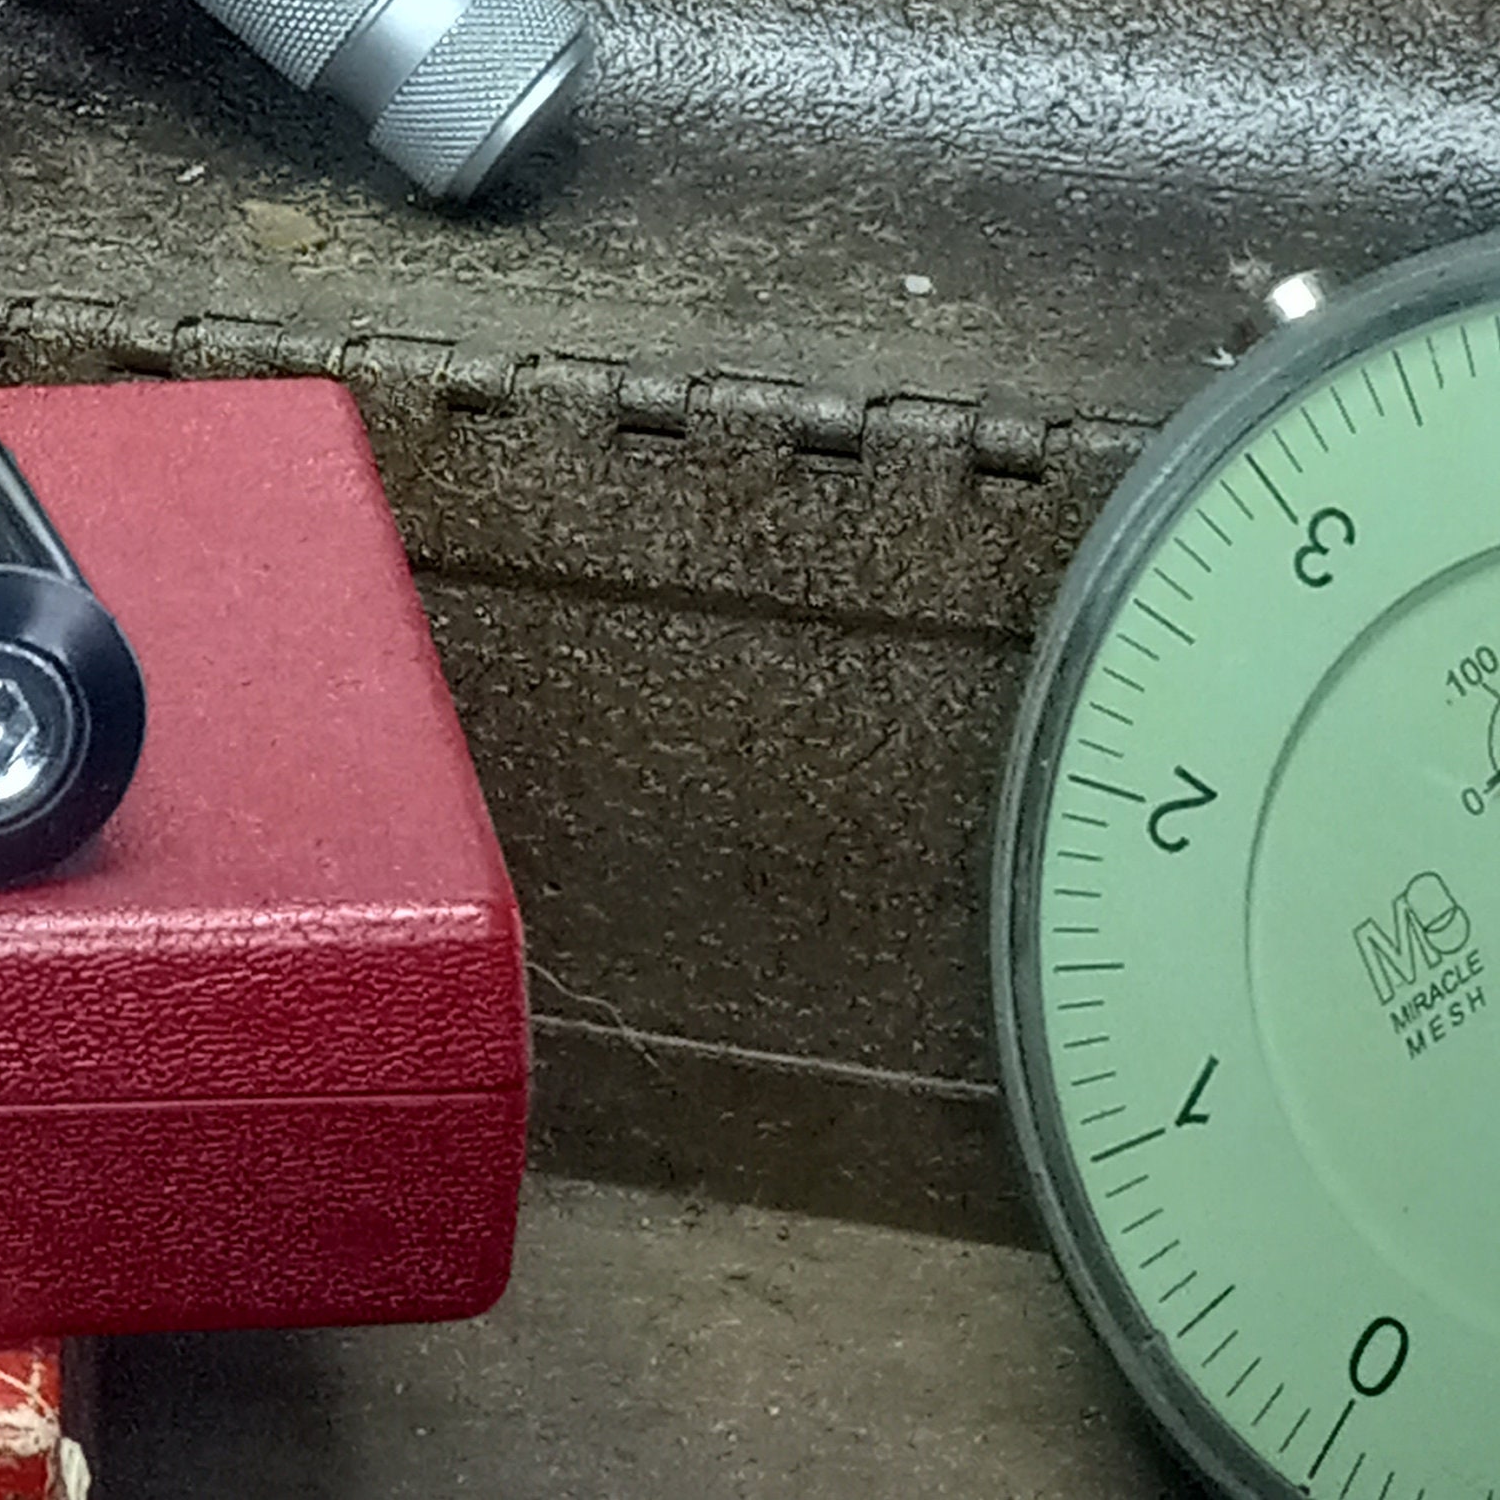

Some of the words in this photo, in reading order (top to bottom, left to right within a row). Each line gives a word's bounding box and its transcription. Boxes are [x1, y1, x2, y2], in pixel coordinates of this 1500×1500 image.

[1294, 507, 1356, 588] 3
[1446, 645, 1498, 697] 100
[1147, 766, 1219, 853] 2
[1461, 787, 1485, 816] 0
[1389, 948, 1485, 1035] MIRACLE
[1405, 986, 1488, 1061] MESH
[1174, 1055, 1220, 1128] 1
[1349, 1316, 1409, 1397] 0
